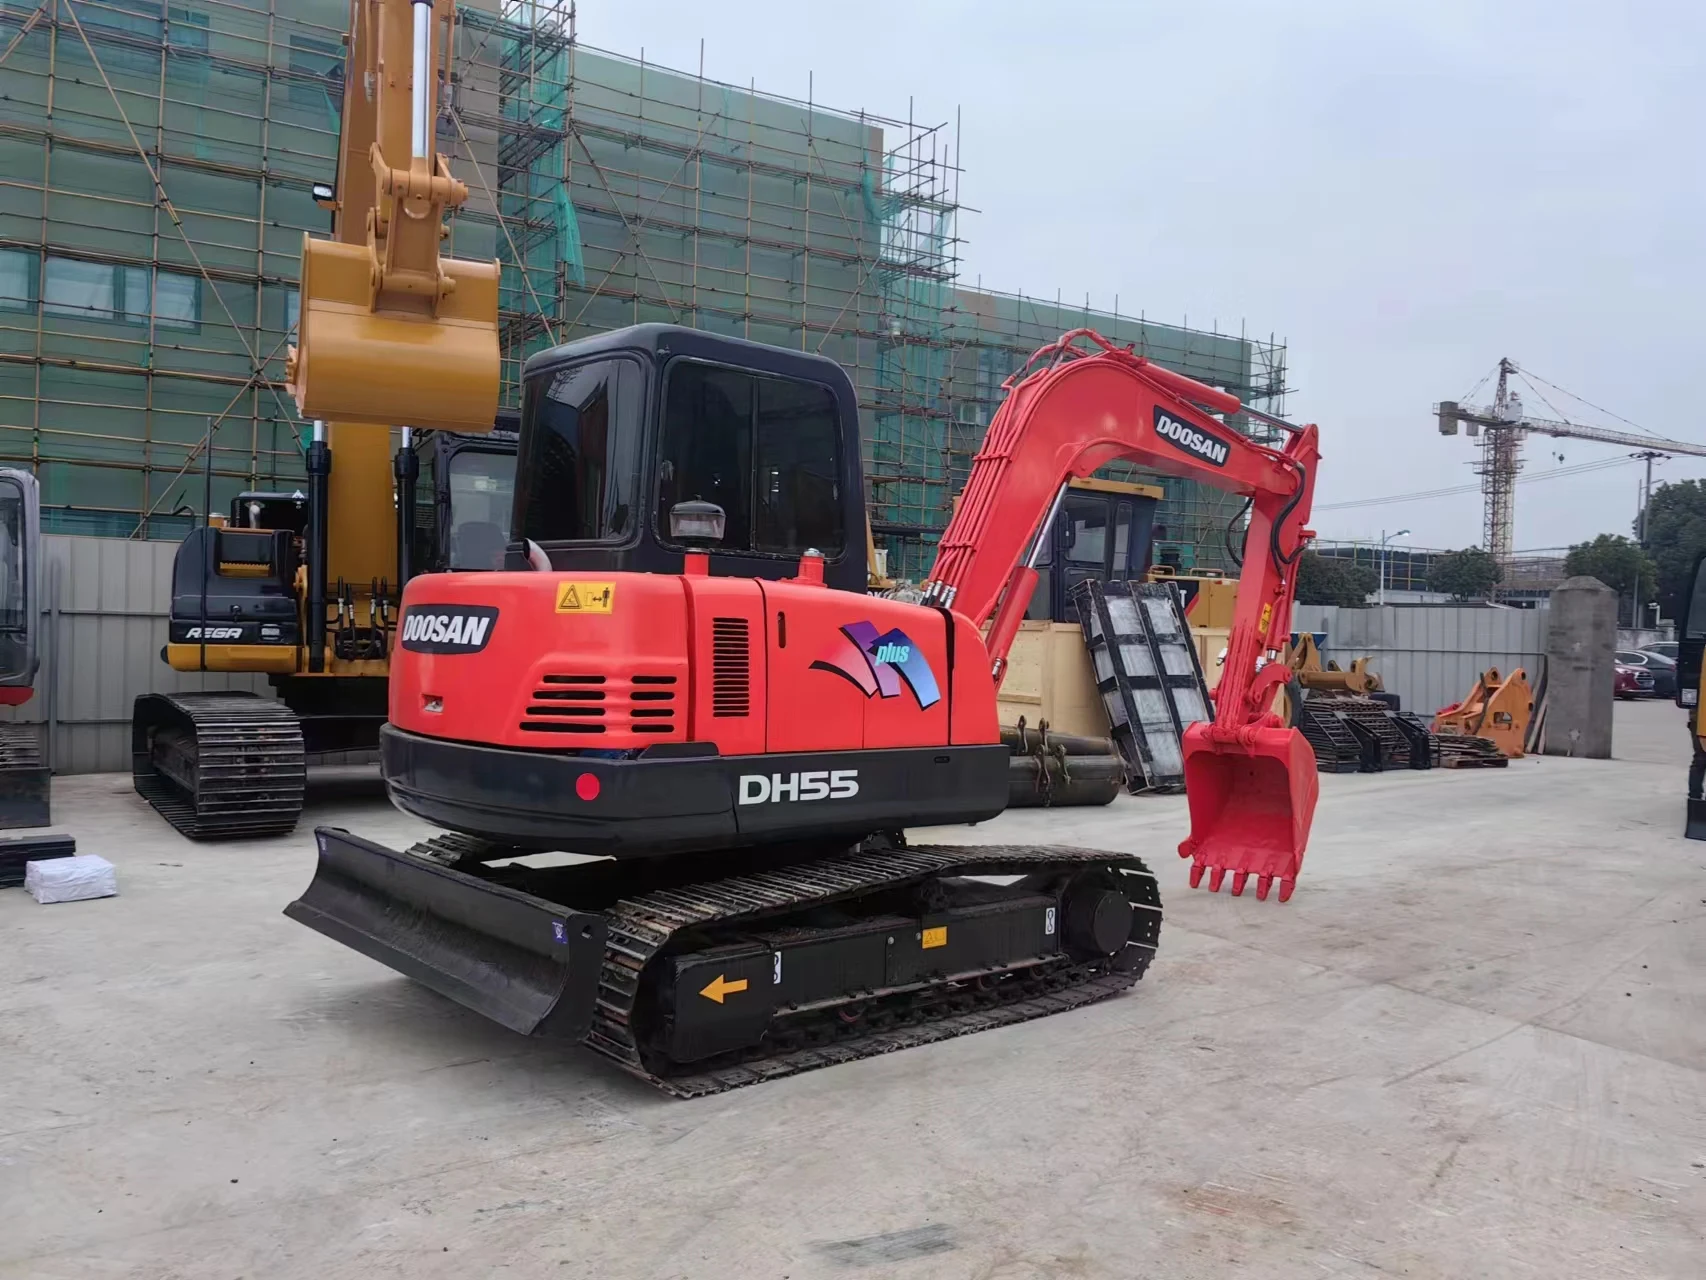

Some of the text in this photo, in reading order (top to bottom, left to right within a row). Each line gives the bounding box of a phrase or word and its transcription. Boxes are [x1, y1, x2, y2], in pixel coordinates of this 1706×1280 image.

[1156, 415, 1227, 463] DOOSAN
[402, 615, 490, 645] DOOSAN
[874, 641, 910, 667] plus
[738, 769, 860, 805] DH55
